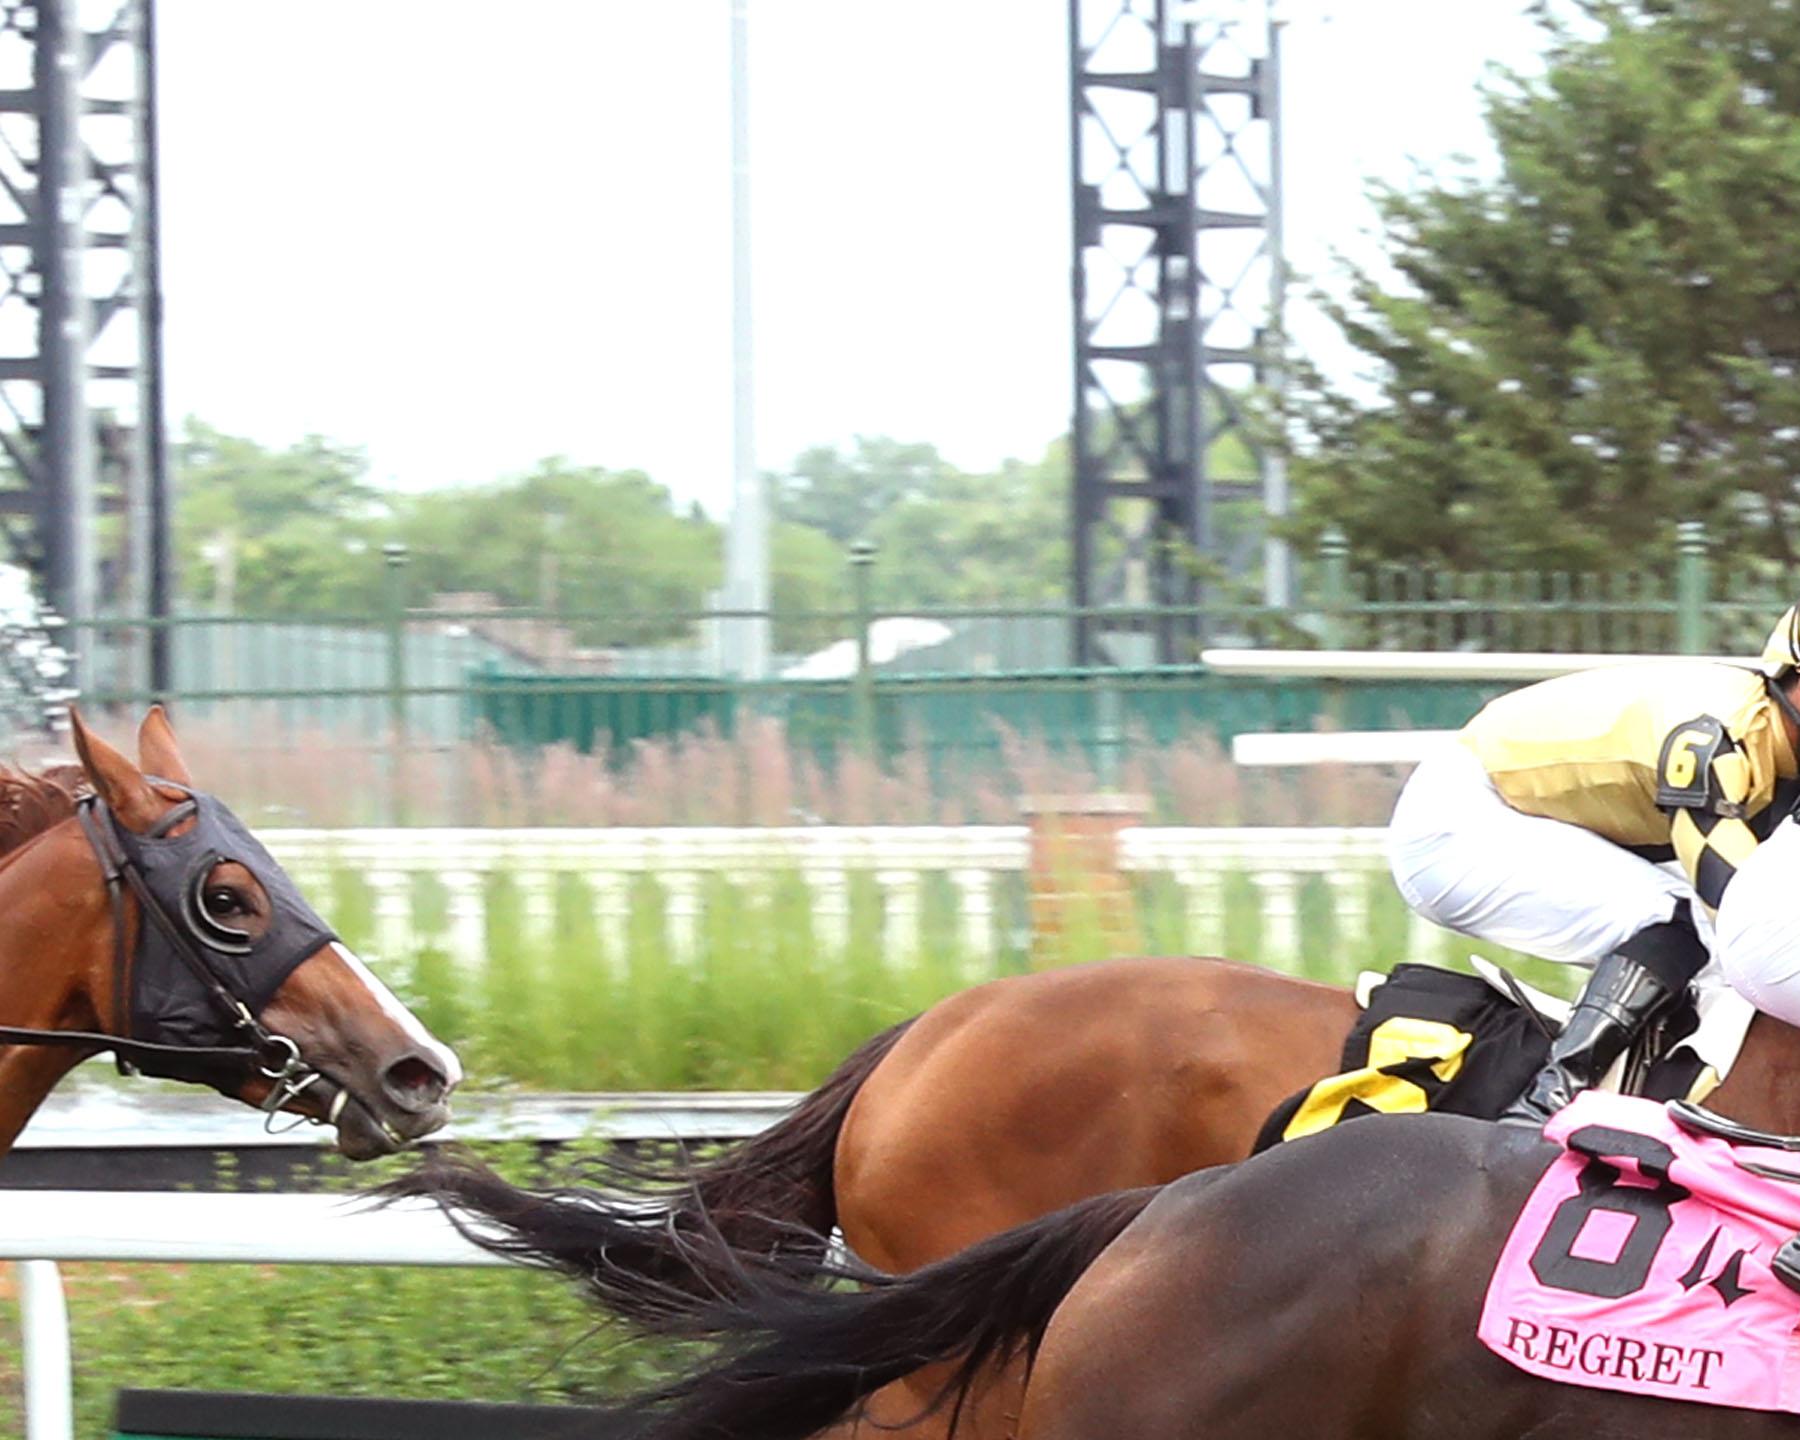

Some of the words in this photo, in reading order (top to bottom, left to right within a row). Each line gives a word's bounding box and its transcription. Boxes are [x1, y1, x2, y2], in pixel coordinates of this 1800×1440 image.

[1665, 729, 1715, 789] 6
[1528, 1123, 1692, 1299] 8
[1503, 1316, 1724, 1390] REGRET
